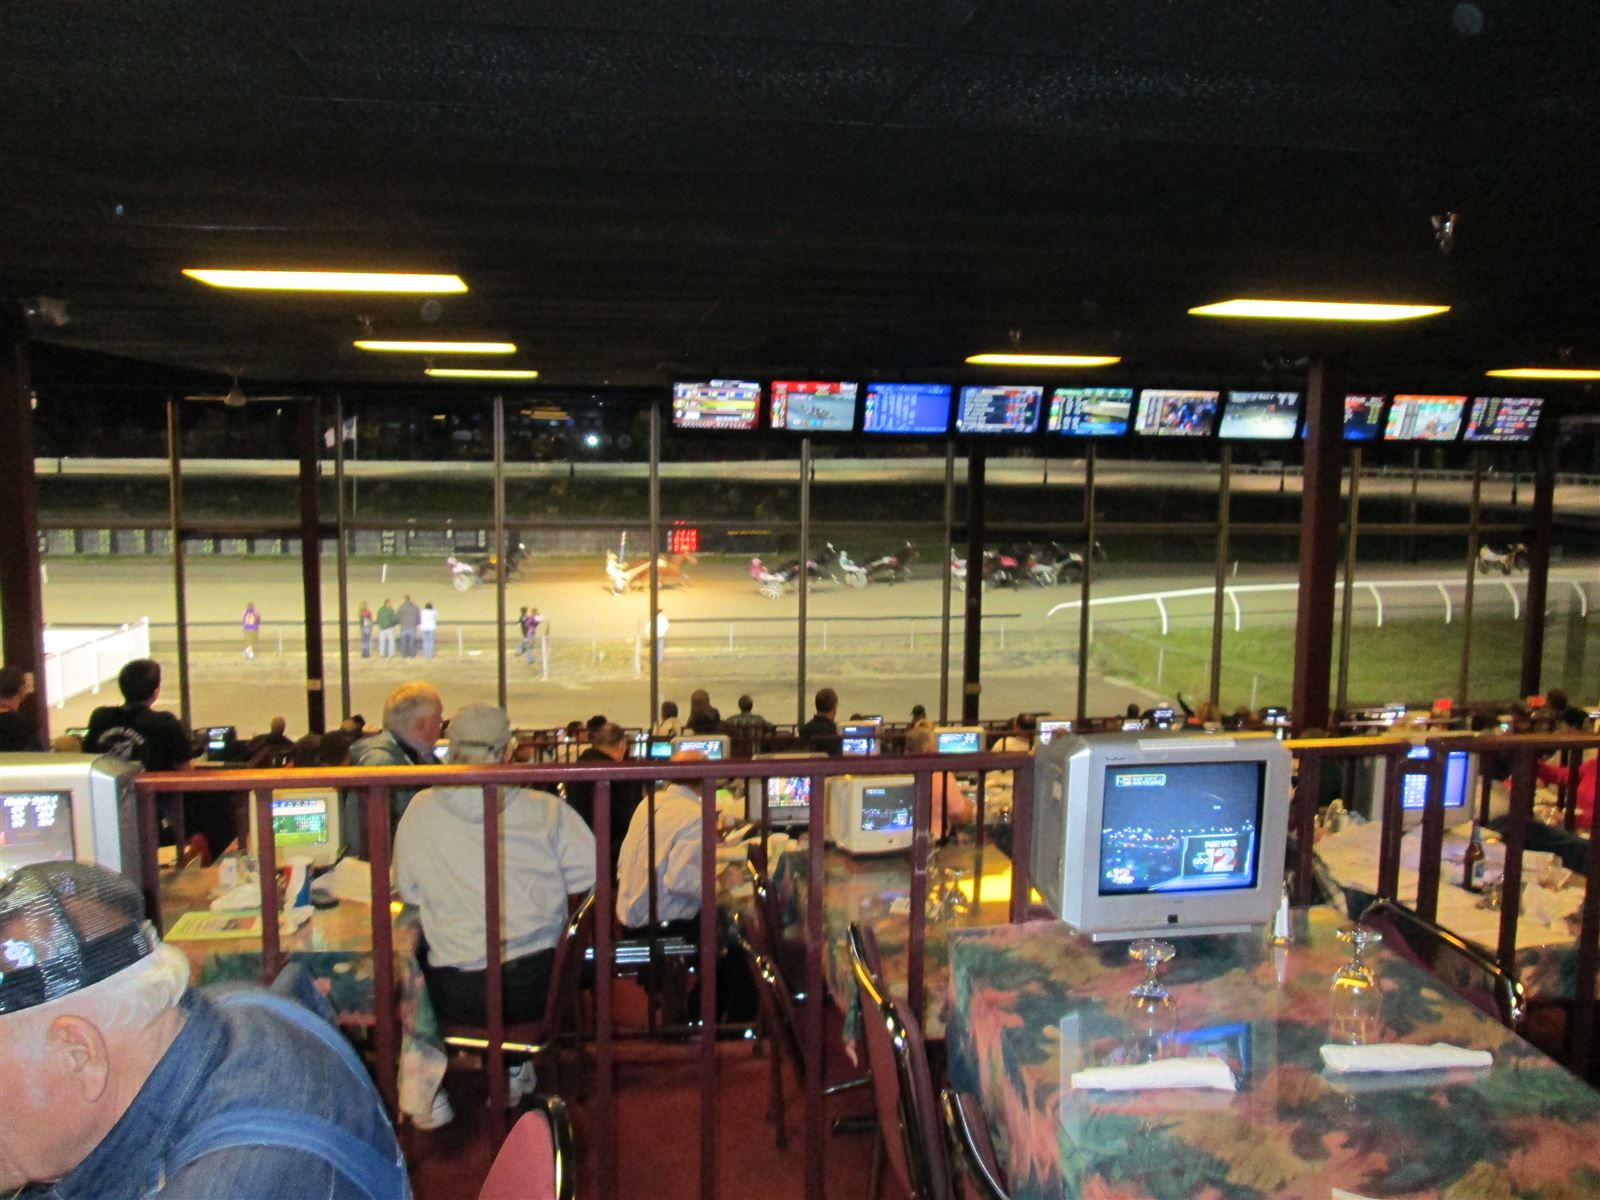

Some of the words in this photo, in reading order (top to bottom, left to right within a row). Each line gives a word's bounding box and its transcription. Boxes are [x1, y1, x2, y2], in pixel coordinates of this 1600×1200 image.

[1204, 839, 1238, 848] NEWS
[1193, 857, 1209, 865] abc
[1204, 848, 1236, 873] 12
